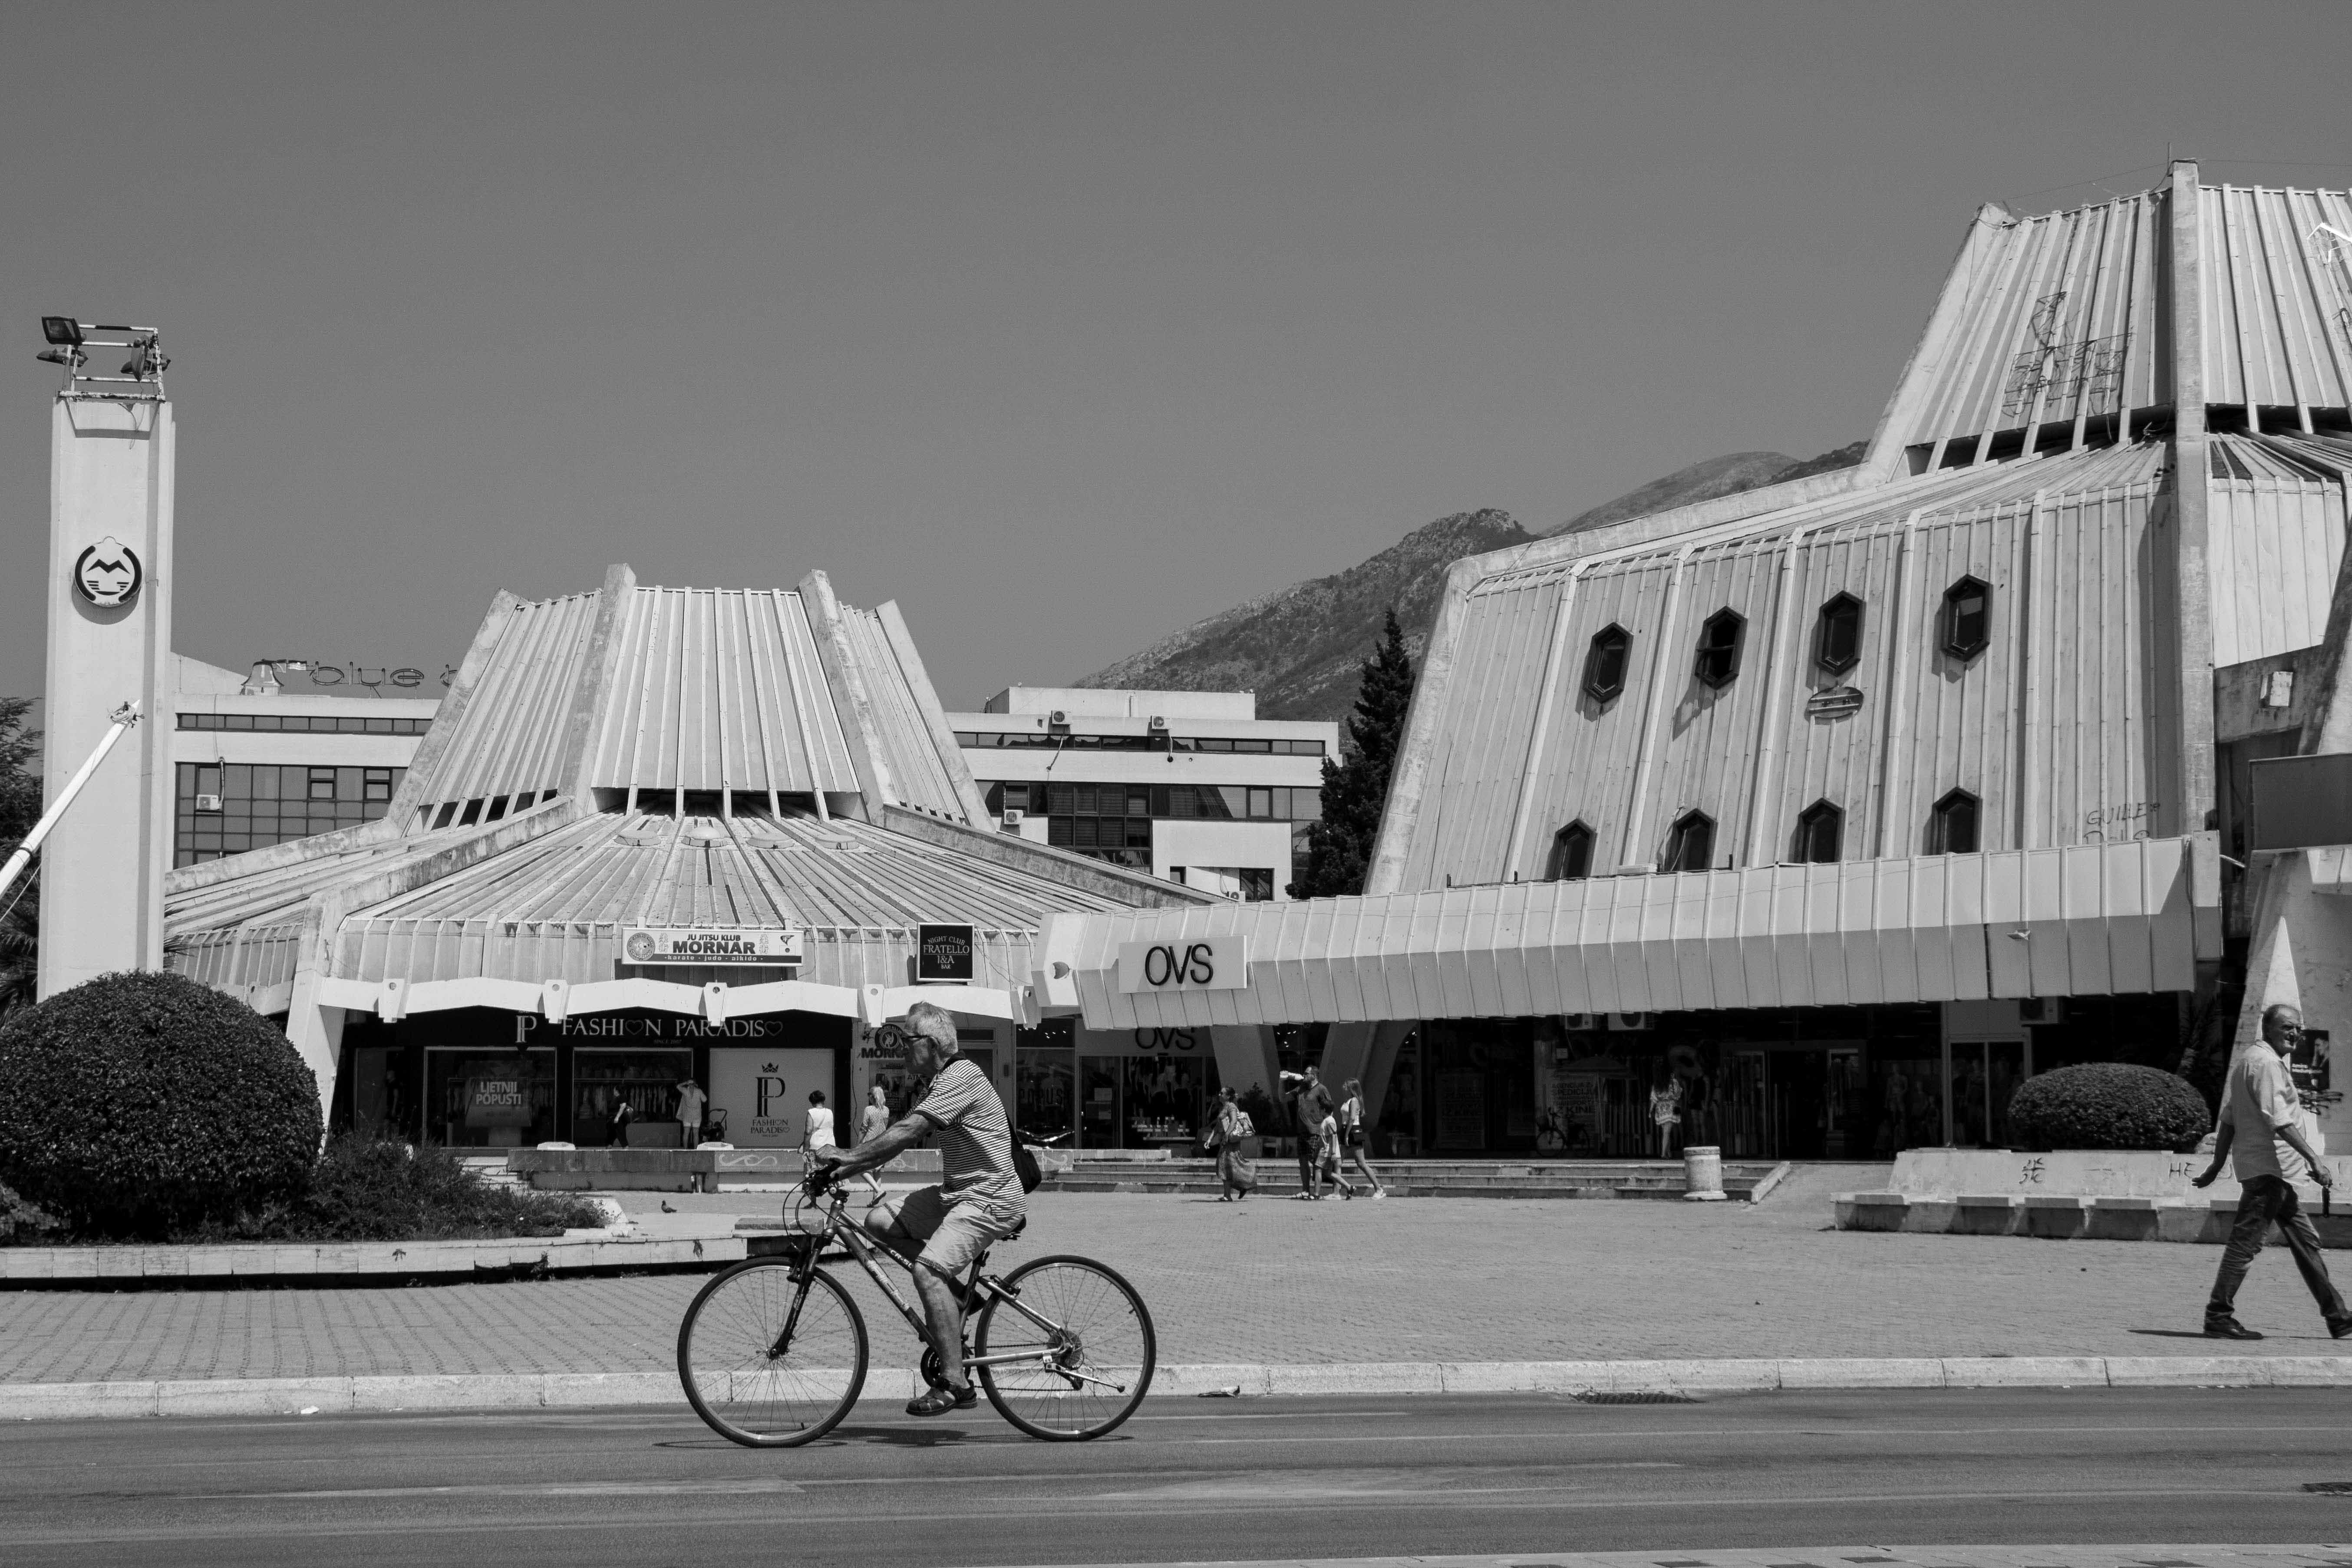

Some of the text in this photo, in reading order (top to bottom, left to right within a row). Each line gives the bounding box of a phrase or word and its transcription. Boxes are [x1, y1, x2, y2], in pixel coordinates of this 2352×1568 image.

[310, 661, 424, 687] blue
[927, 936, 965, 945] NIGHT CLUB
[673, 941, 756, 954] MORNAR
[923, 945, 970, 954] FRATELLO
[1145, 944, 1213, 986] OVS
[480, 1081, 517, 1093] LJETNJI
[476, 1093, 521, 1105] POPUSTI
